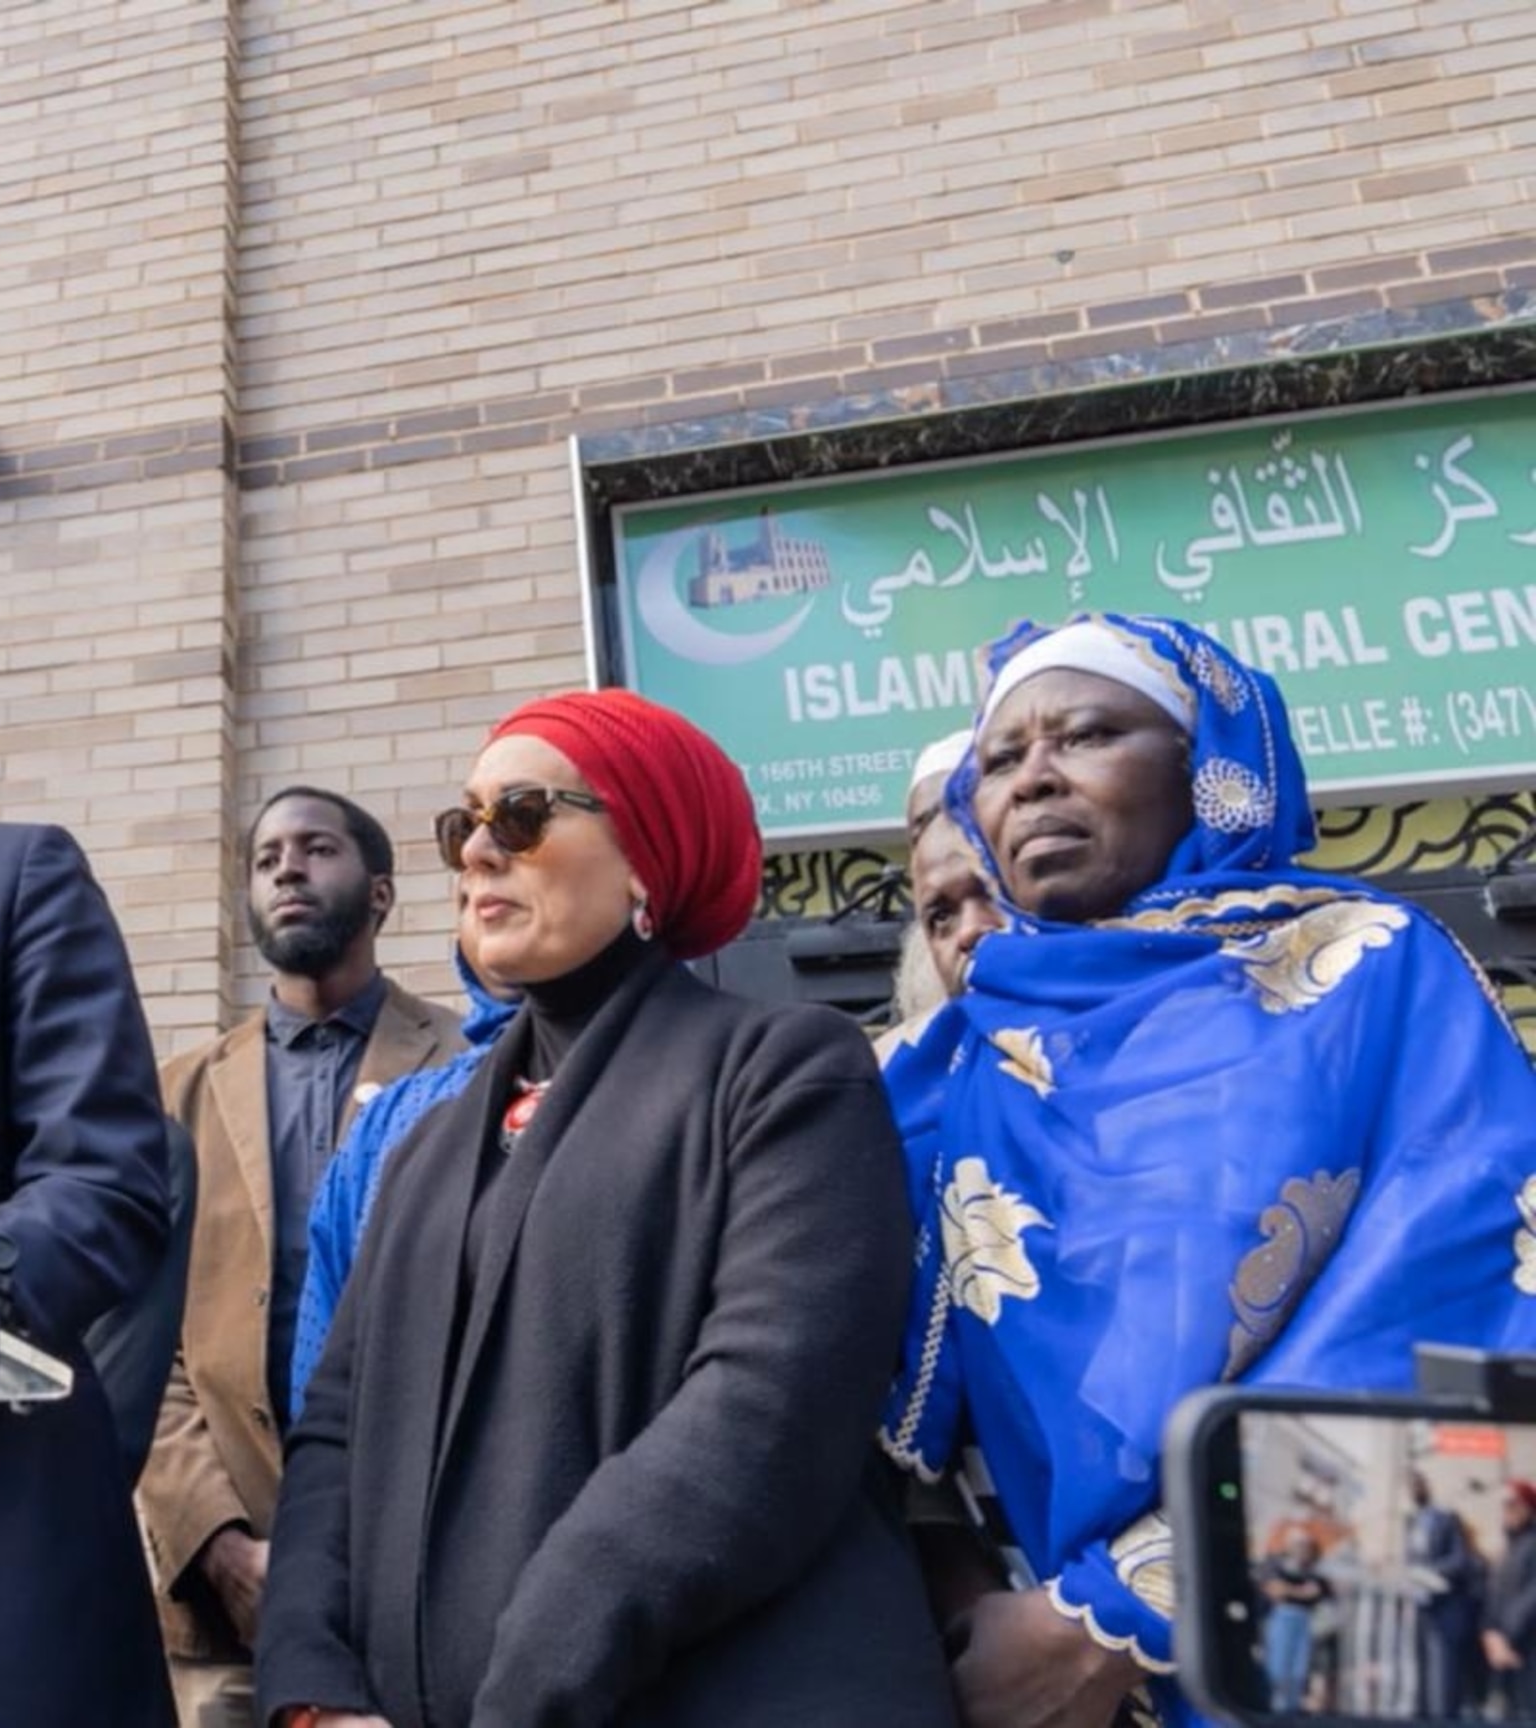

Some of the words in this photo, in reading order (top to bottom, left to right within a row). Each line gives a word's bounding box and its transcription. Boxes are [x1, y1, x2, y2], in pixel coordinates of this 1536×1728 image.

[841, 485, 1119, 638] الإسلامي
[785, 650, 980, 722] ISLAM
[1199, 604, 1390, 672] URAL
[1290, 698, 1399, 757] ELLE
[827, 749, 915, 778] STREET
[784, 789, 815, 812] NY
[819, 783, 883, 809] 10456
